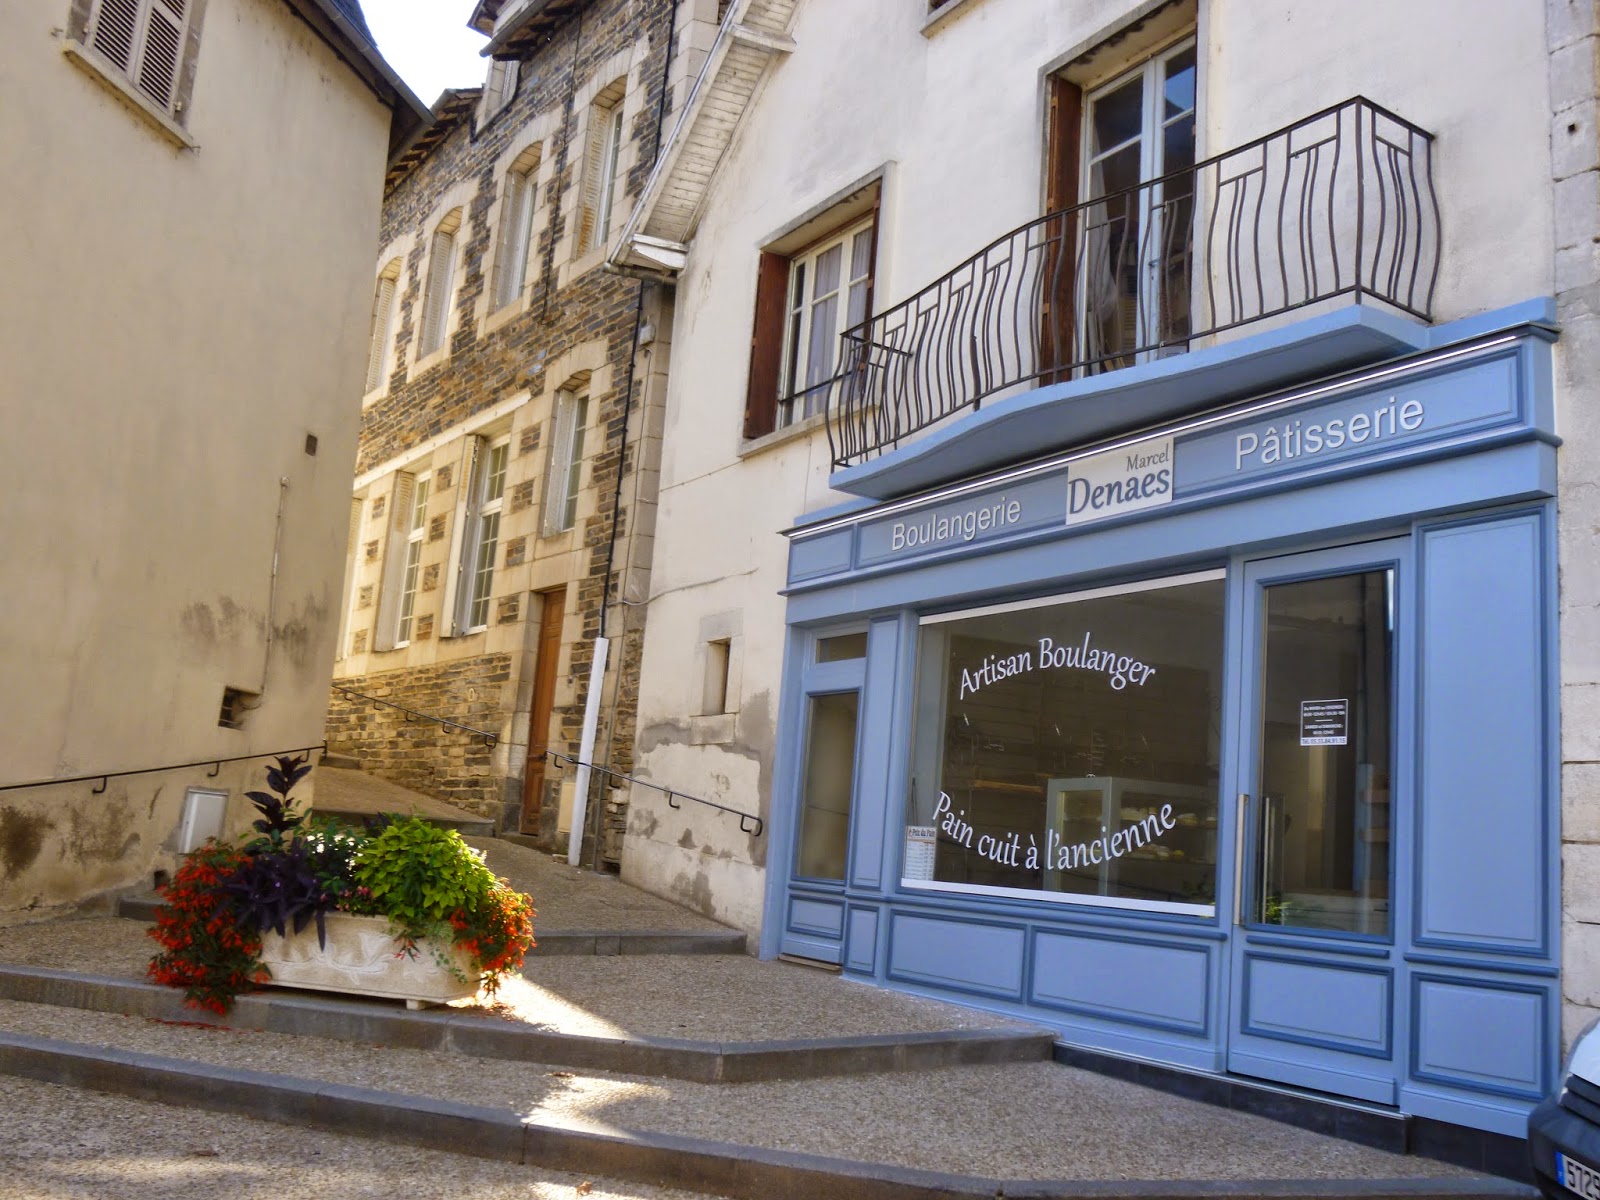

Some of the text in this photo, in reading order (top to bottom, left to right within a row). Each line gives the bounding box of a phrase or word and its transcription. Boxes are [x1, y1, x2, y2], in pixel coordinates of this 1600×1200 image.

[1126, 444, 1170, 473] Marcel
[1235, 398, 1424, 471] Pâtisserie
[1068, 468, 1171, 515] Denaes
[891, 498, 1022, 551] Boulangerie
[959, 632, 1156, 701] Artisan Boulanger
[931, 790, 973, 849] Pain
[977, 831, 1021, 867] cuit
[1025, 834, 1040, 870] à
